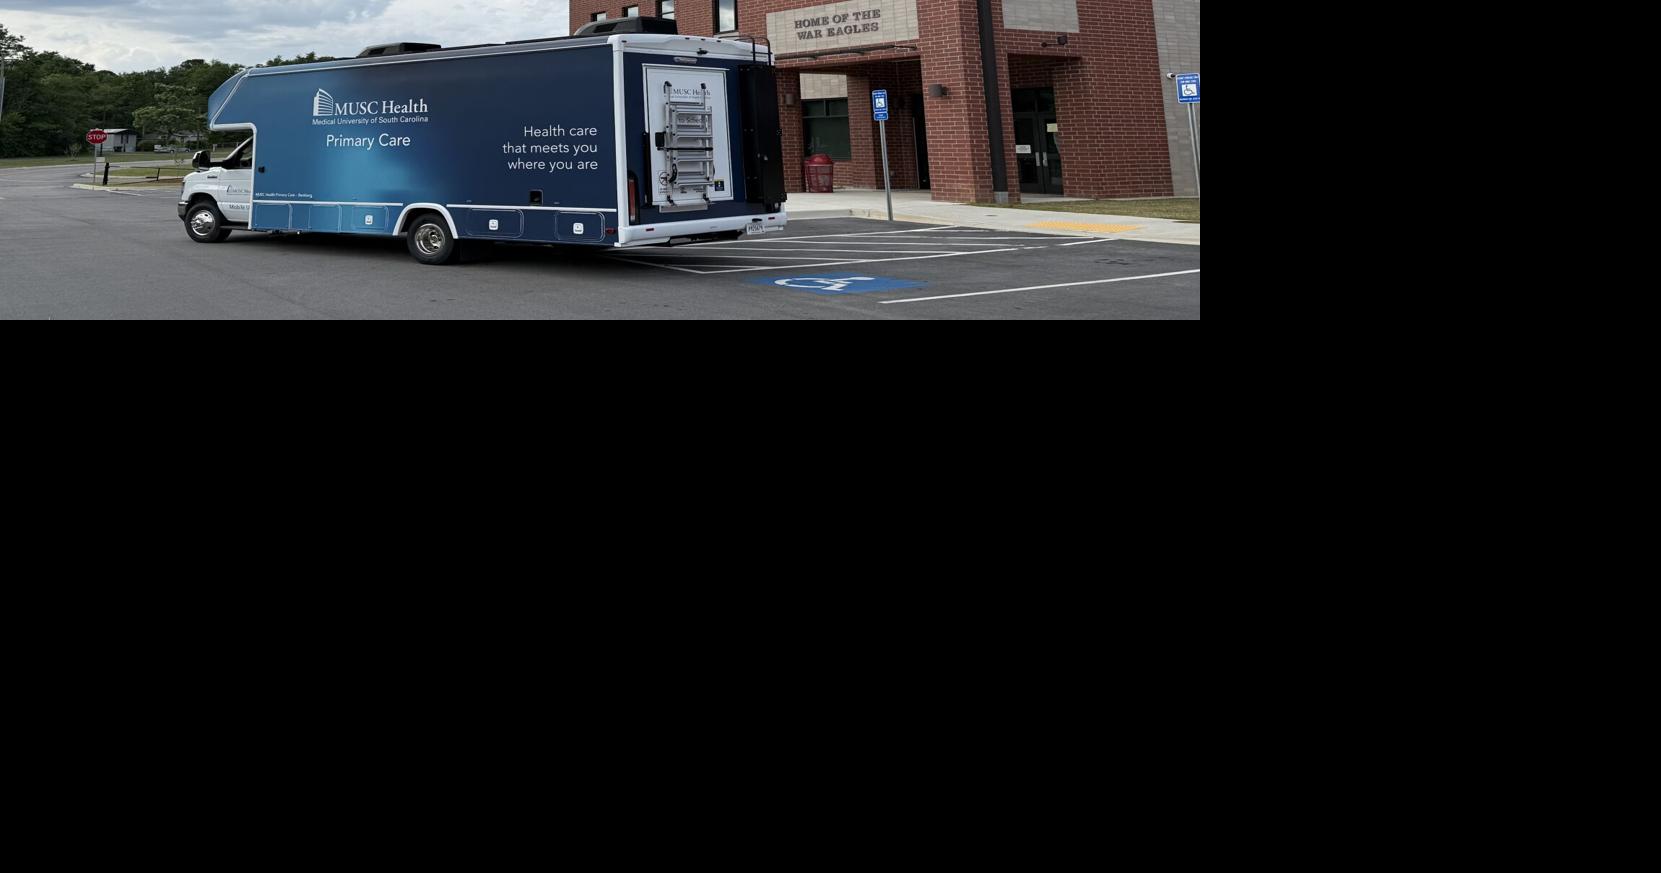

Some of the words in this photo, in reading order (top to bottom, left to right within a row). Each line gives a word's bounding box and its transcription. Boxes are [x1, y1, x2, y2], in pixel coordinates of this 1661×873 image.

[794, 16, 829, 29] HOME
[832, 13, 849, 24] OF
[852, 9, 881, 20] THE
[797, 29, 822, 40] WAR
[826, 22, 879, 37] EAGLES
[335, 101, 378, 116] MUSC
[382, 98, 428, 114] Health
[312, 118, 336, 126] Medical
[337, 117, 369, 125] University
[378, 116, 399, 124] South
[400, 115, 429, 123] Carolina
[524, 124, 565, 137] Health
[569, 127, 598, 136] care
[326, 134, 375, 151] Primary
[379, 133, 411, 147] Care
[502, 141, 527, 154] that
[530, 143, 570, 153] meets
[573, 144, 598, 156] you
[507, 157, 546, 170] where
[549, 161, 573, 173] you
[577, 160, 598, 170] are
